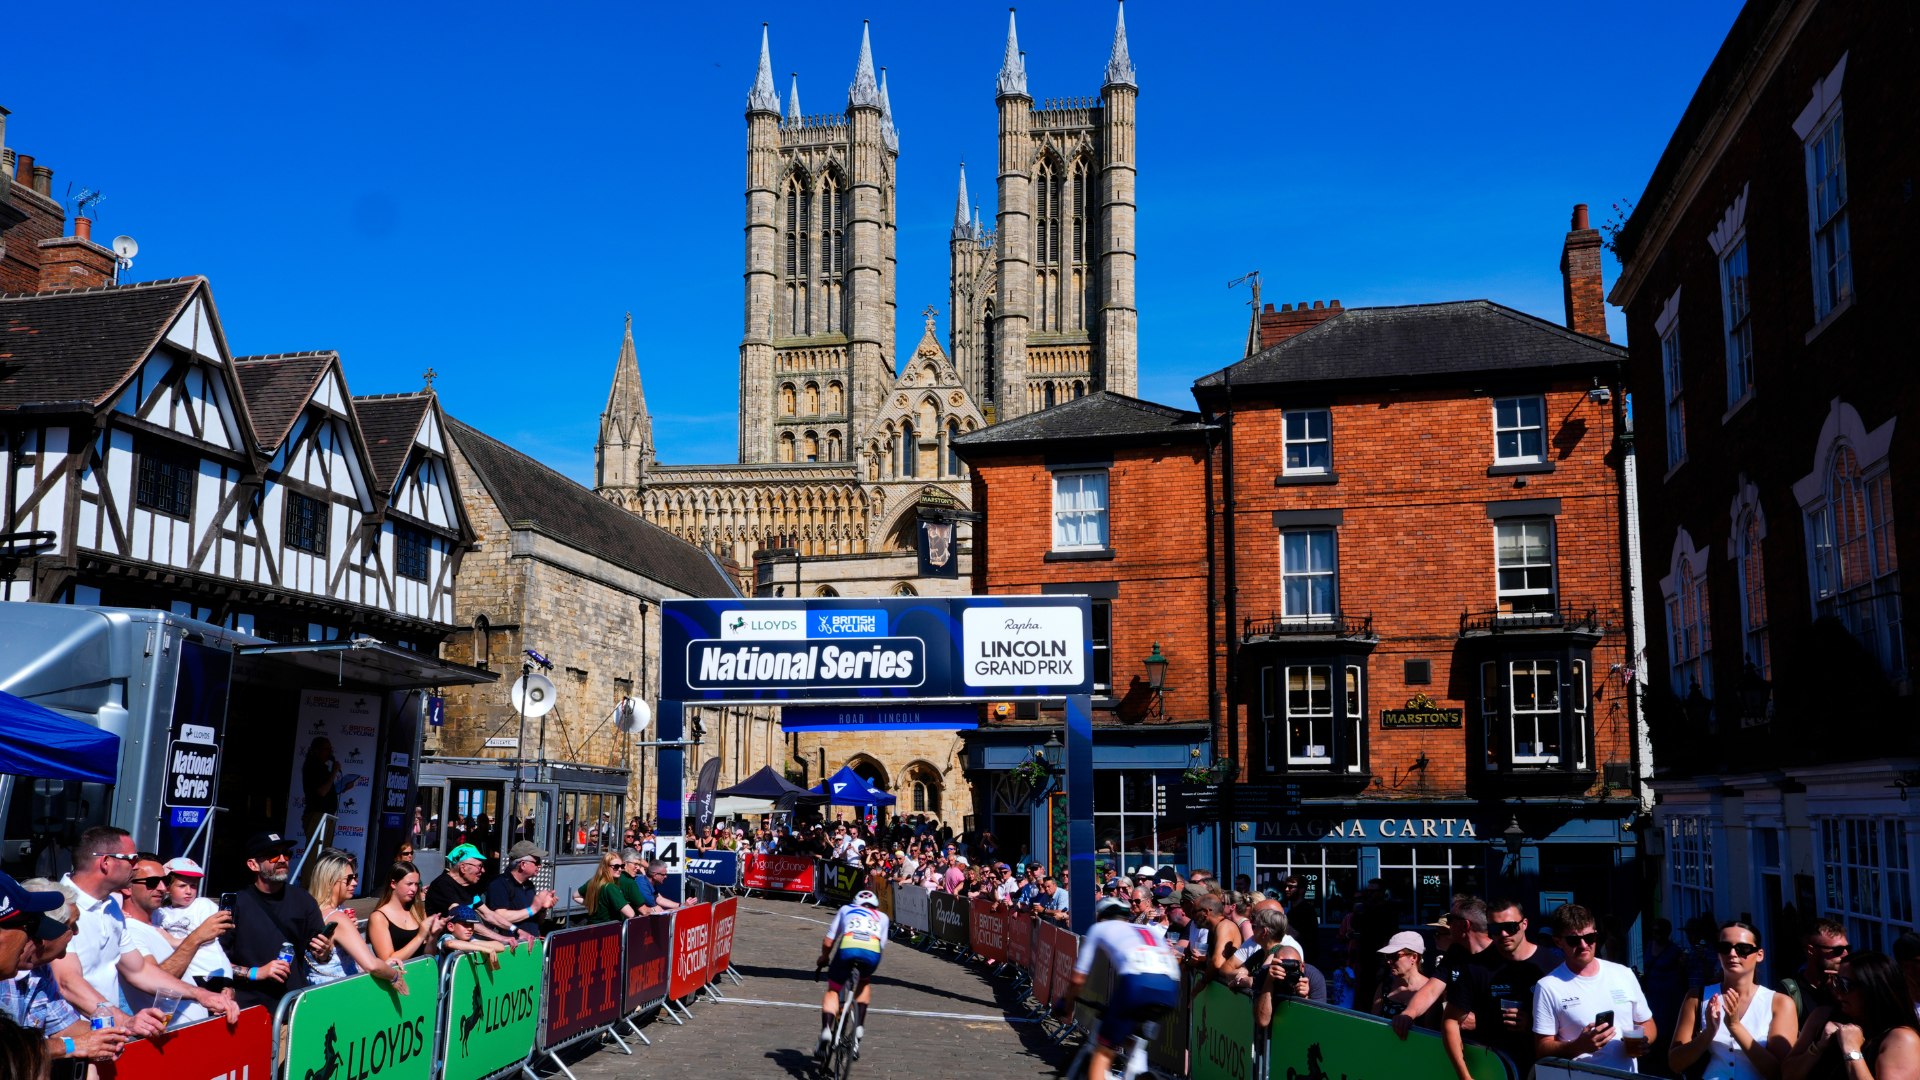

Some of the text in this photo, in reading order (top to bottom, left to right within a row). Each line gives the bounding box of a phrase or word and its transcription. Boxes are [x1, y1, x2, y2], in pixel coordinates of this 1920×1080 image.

[921, 496, 954, 505] MARSTON'S
[751, 620, 797, 631] LLOYDS
[832, 615, 876, 624] BRITISH
[832, 624, 876, 633] CYCLING
[1004, 617, 1042, 635] Rapha.
[981, 640, 1067, 658] LINCOLN
[700, 645, 914, 681] National Series
[975, 660, 1073, 675] GRAND PRIX
[839, 713, 920, 724] ROAD LINCOLN
[1385, 712, 1459, 724] MARSTON'S
[194, 731, 210, 739] LLOYDS
[172, 750, 216, 776] National
[174, 774, 209, 799] Series
[386, 771, 410, 790] National
[387, 789, 406, 807] Series
[1261, 818, 1477, 838] MAGNA CARTA
[658, 842, 680, 867] 4
[685, 858, 722, 868] ANT
[782, 860, 806, 872] Crone
[935, 898, 963, 935] Rapha.
[979, 912, 1004, 934] BRITISH
[686, 922, 709, 952] BRITISH
[979, 929, 1003, 950] CYCLING
[686, 946, 708, 975] CYCLING
[485, 984, 535, 1035] LLOYDS
[347, 1015, 425, 1080] LLOYDS
[1209, 1026, 1246, 1080] LLOYDS
